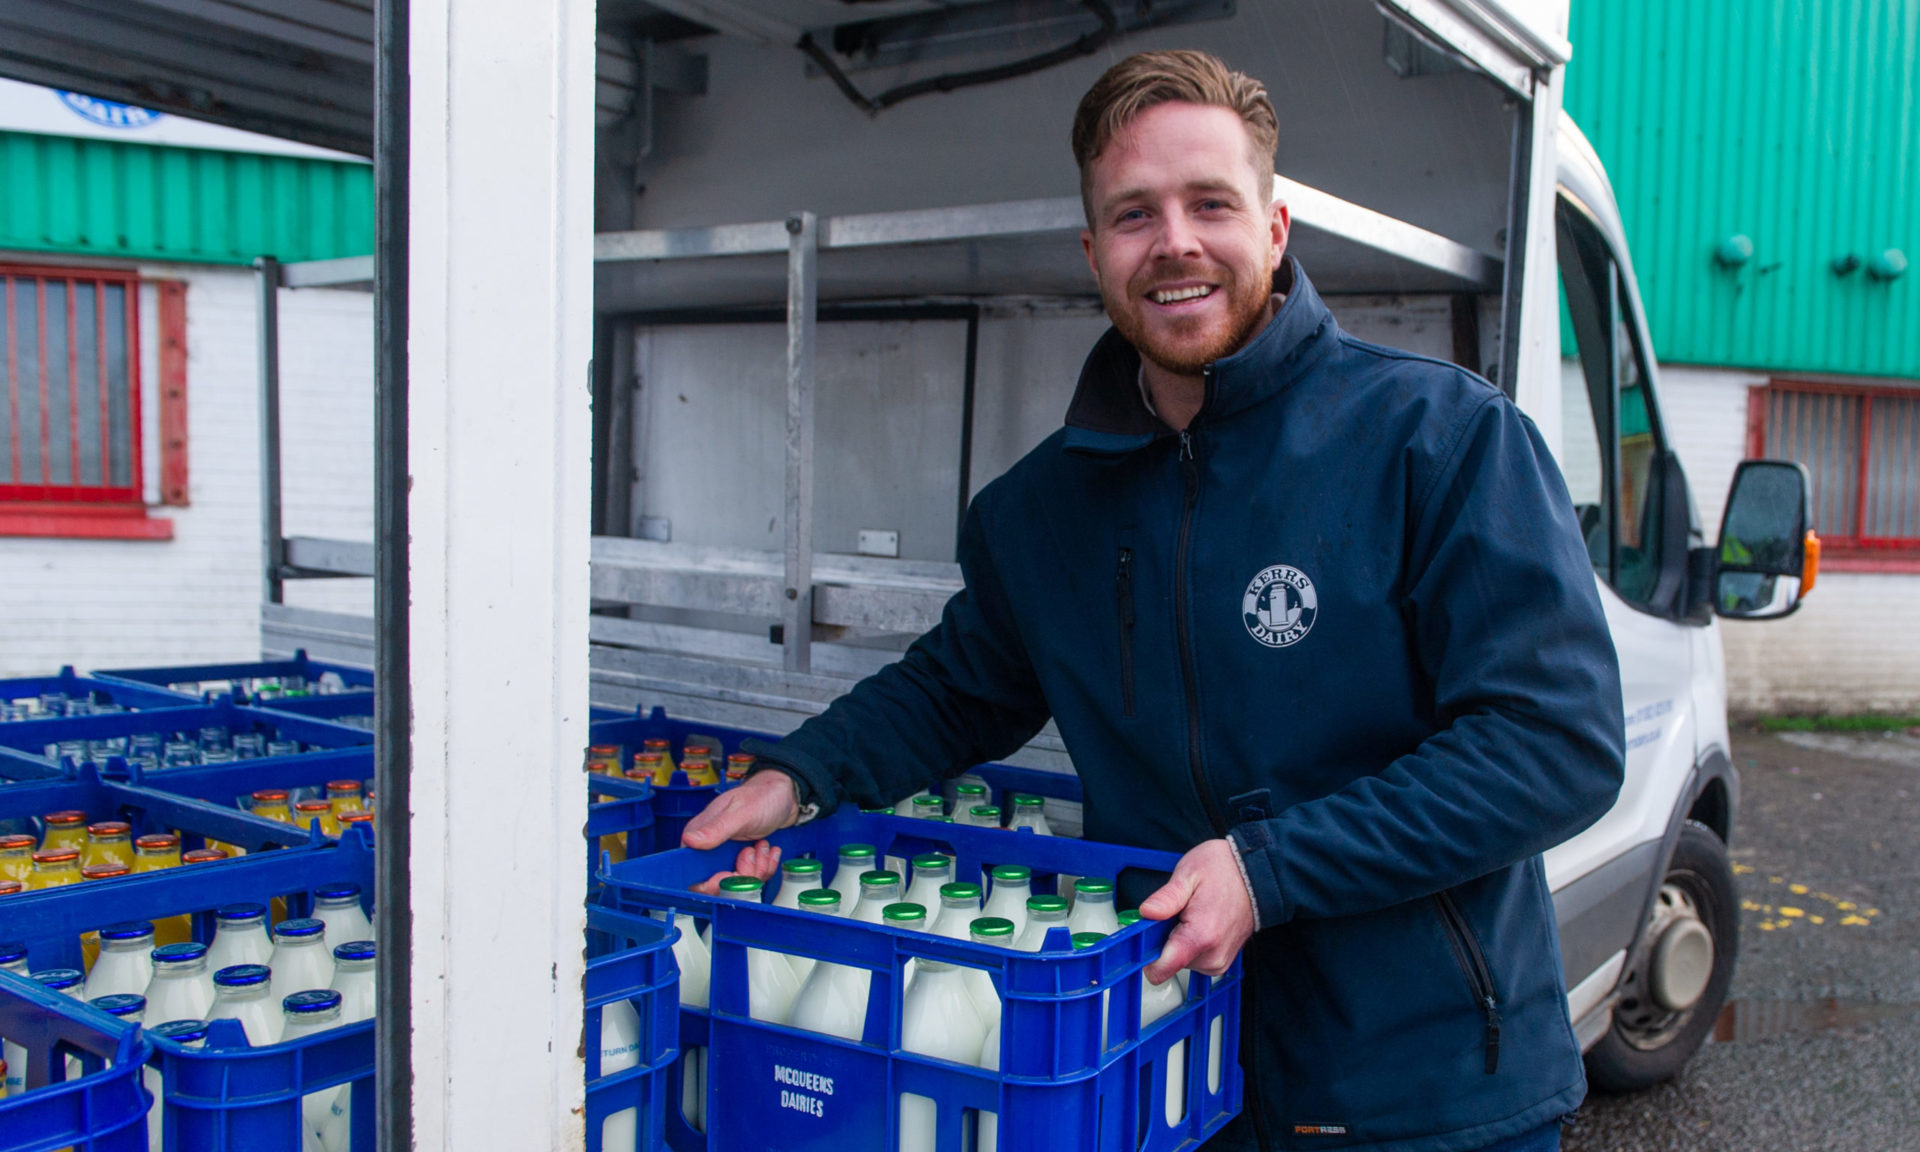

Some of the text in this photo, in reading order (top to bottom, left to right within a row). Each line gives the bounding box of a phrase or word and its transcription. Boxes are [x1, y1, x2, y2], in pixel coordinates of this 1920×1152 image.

[1248, 568, 1310, 597] KERRS
[1251, 620, 1309, 645] DAIRY
[602, 1046, 628, 1057] TURN
[774, 1064, 834, 1096] MCQUEENS
[780, 1089, 824, 1118] DAIRIES
